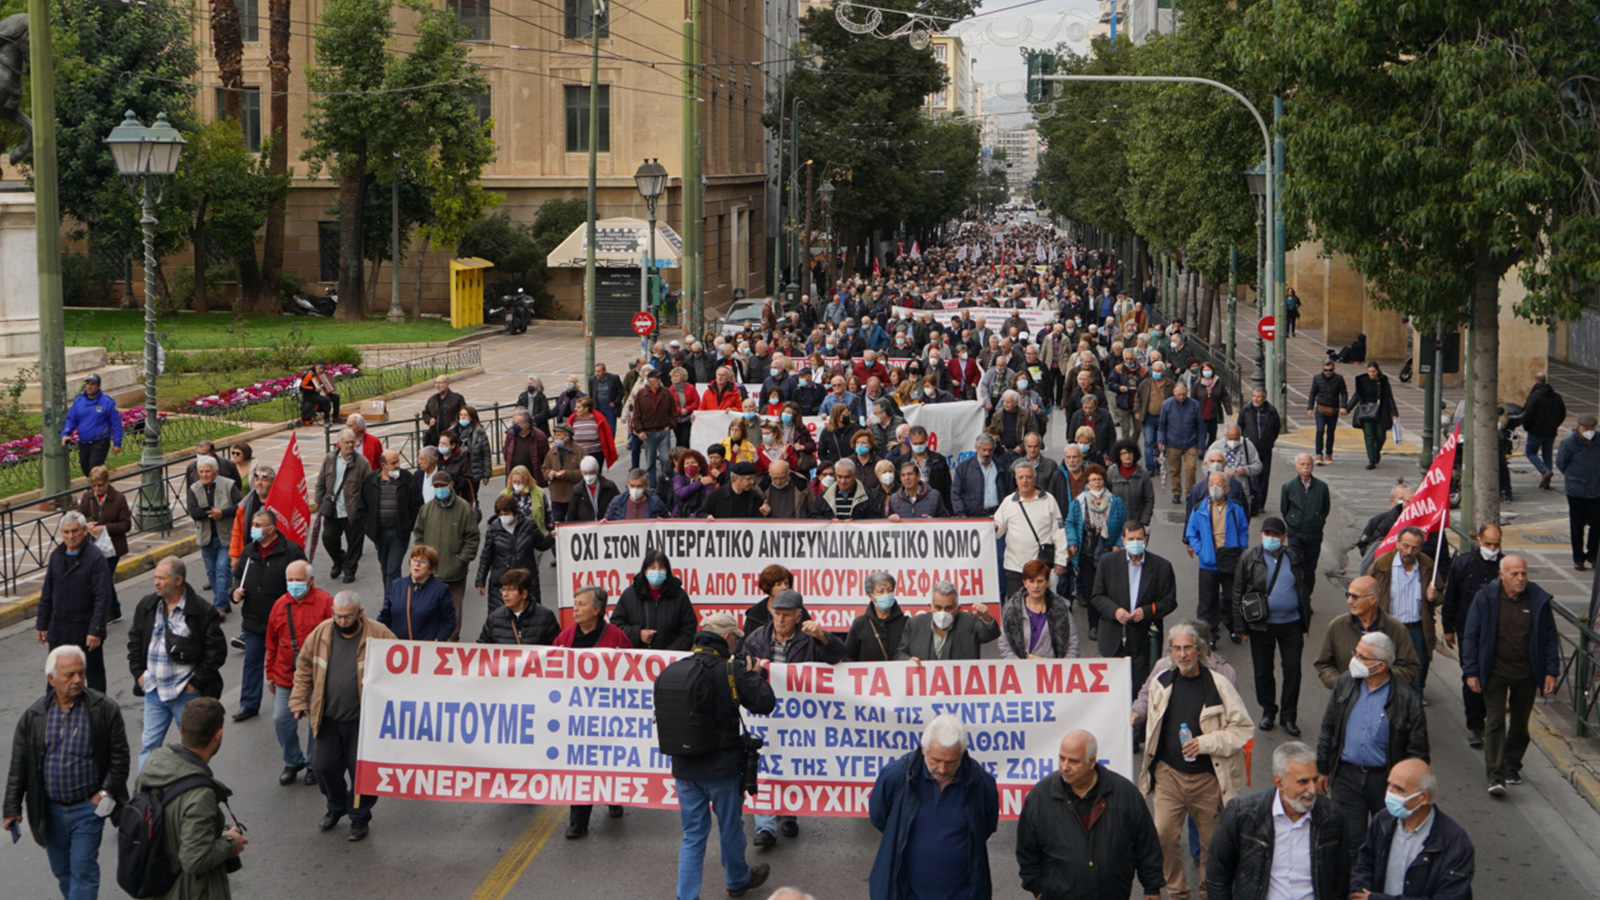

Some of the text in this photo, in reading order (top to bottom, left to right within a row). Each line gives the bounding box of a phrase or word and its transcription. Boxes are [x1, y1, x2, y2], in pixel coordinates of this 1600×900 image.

[571, 529, 981, 562] ΟΧΙ ΣΤΟΝ ΑΝΤΕΡΓΑΤΙΚΟ ΑΝΤΙΣΥΝΔΙΚΑΛΙΣΤΙΚΟ ΝΟΜΟ
[705, 572, 737, 597] ΑΠΟ
[742, 572, 769, 597] ΤΗ
[385, 643, 422, 675] ΟΙ
[786, 664, 834, 694] ΜΕ
[848, 667, 892, 697] ΤΑ
[905, 664, 1023, 697] ΠΑΙΔΙΑ
[1036, 663, 1110, 694] ΜΑΣ
[379, 700, 536, 745] ΑΠΑΙΤΟΥΜΕ
[568, 686, 653, 710] ΑΥΞΗΣΕ
[855, 705, 886, 723] ΚΑΙ
[894, 706, 924, 725] ΤΙΣ
[931, 701, 1057, 724] ΣΥΝΤΑΞΕΙΣ
[567, 714, 653, 739] ΜΕΙΩΣΗ
[777, 728, 816, 747] ΤΩΝ
[825, 726, 923, 751] ΒΑΣΙΚΩΝ
[567, 743, 642, 768] ΜΕΤΡΑ
[791, 758, 828, 776] ΤΗΣ
[835, 755, 896, 777] ΥΓΕΙ
[1006, 757, 1054, 780] ΖΩΗ
[376, 766, 649, 804] ΣΥΝΕΡΓΑΖΟΜΕΝΕΣ
